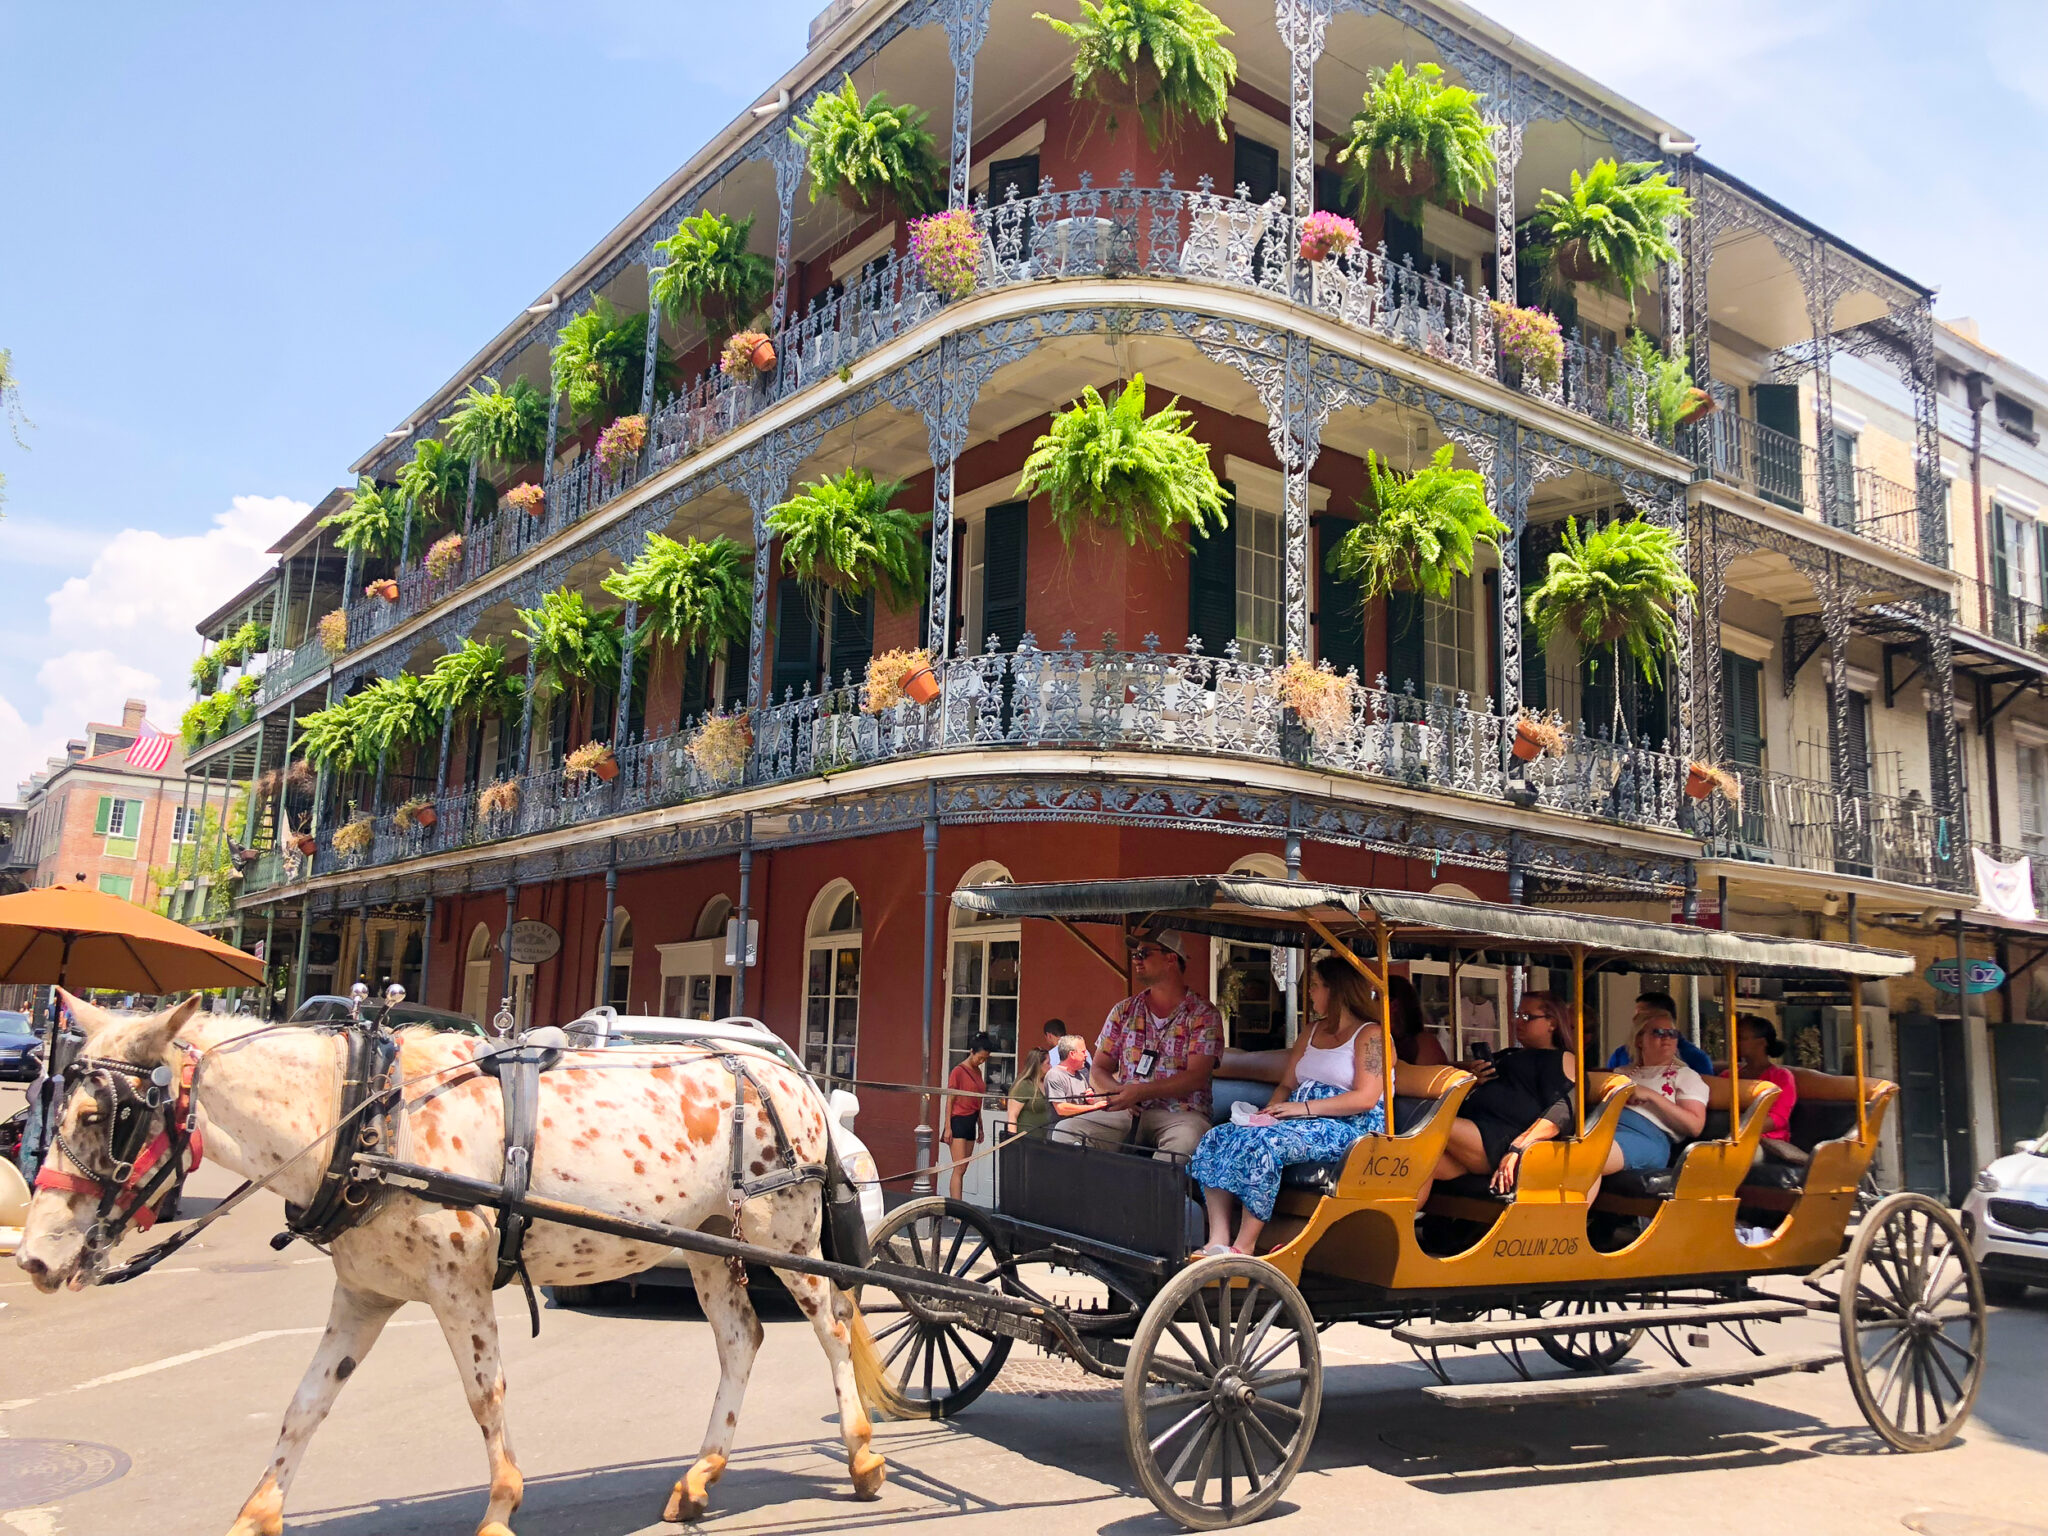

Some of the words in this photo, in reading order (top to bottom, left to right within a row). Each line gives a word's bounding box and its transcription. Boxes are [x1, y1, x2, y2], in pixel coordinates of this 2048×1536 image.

[511, 925, 553, 939] OREVER
[1362, 1156, 1389, 1176] AC
[1390, 1157, 1409, 1177] 26
[1493, 1239, 1548, 1257] ROLLIN
